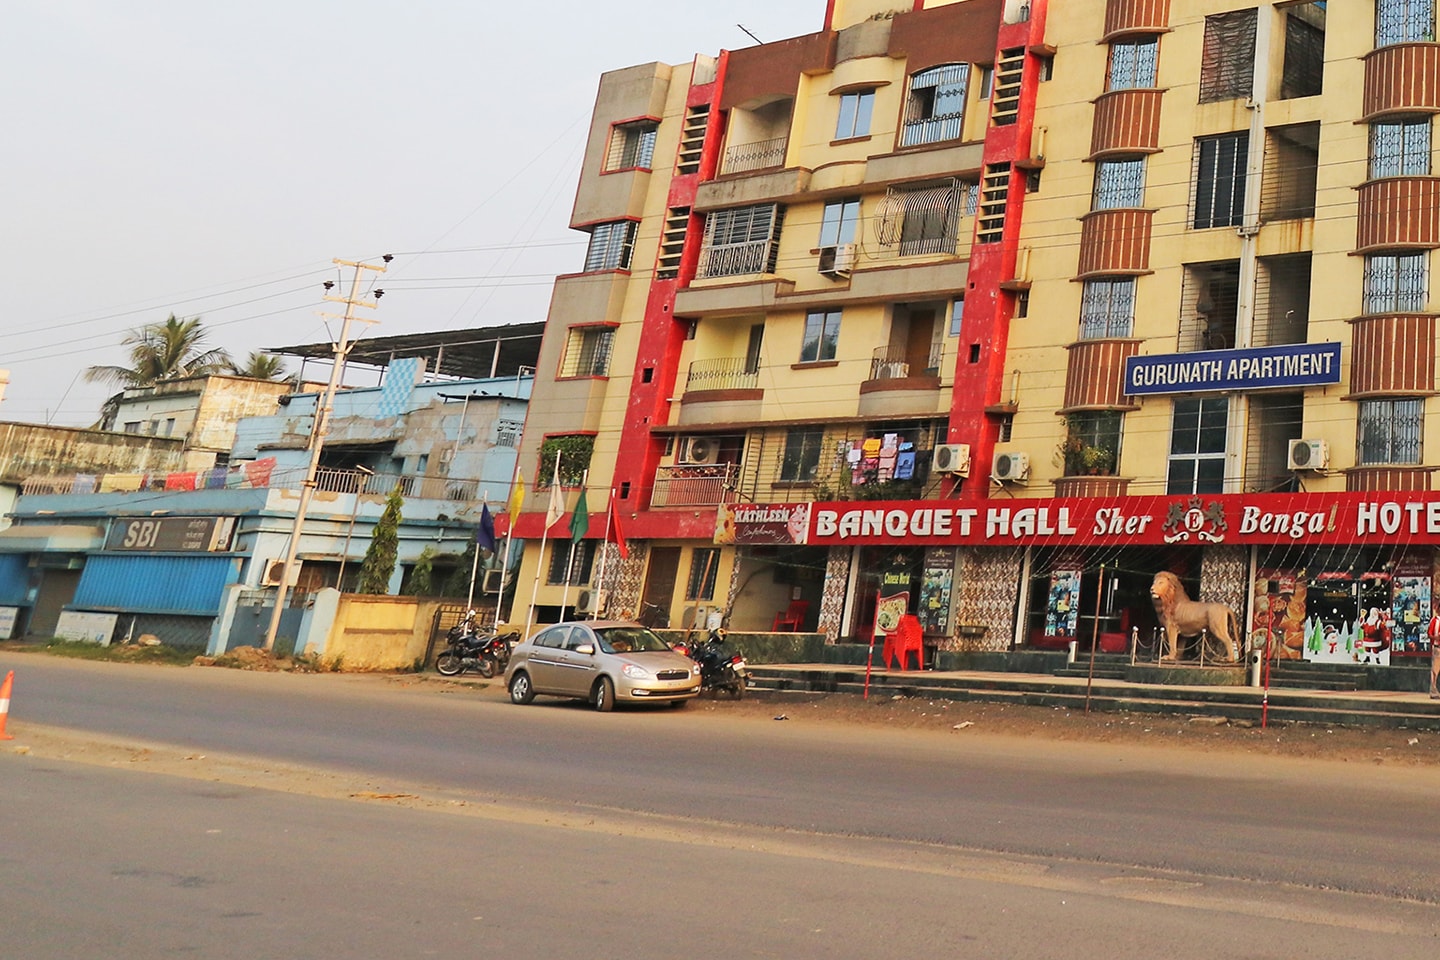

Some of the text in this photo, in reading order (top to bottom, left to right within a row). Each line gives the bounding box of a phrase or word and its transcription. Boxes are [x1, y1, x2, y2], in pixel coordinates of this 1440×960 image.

[1132, 352, 1335, 387] GURUNATH APARTMENT
[734, 509, 790, 523] KATHLEEN
[816, 507, 1077, 539] BANQUET HALL
[1093, 507, 1153, 535] Sher
[1239, 505, 1338, 538] Bengal
[123, 520, 162, 548] SBI
